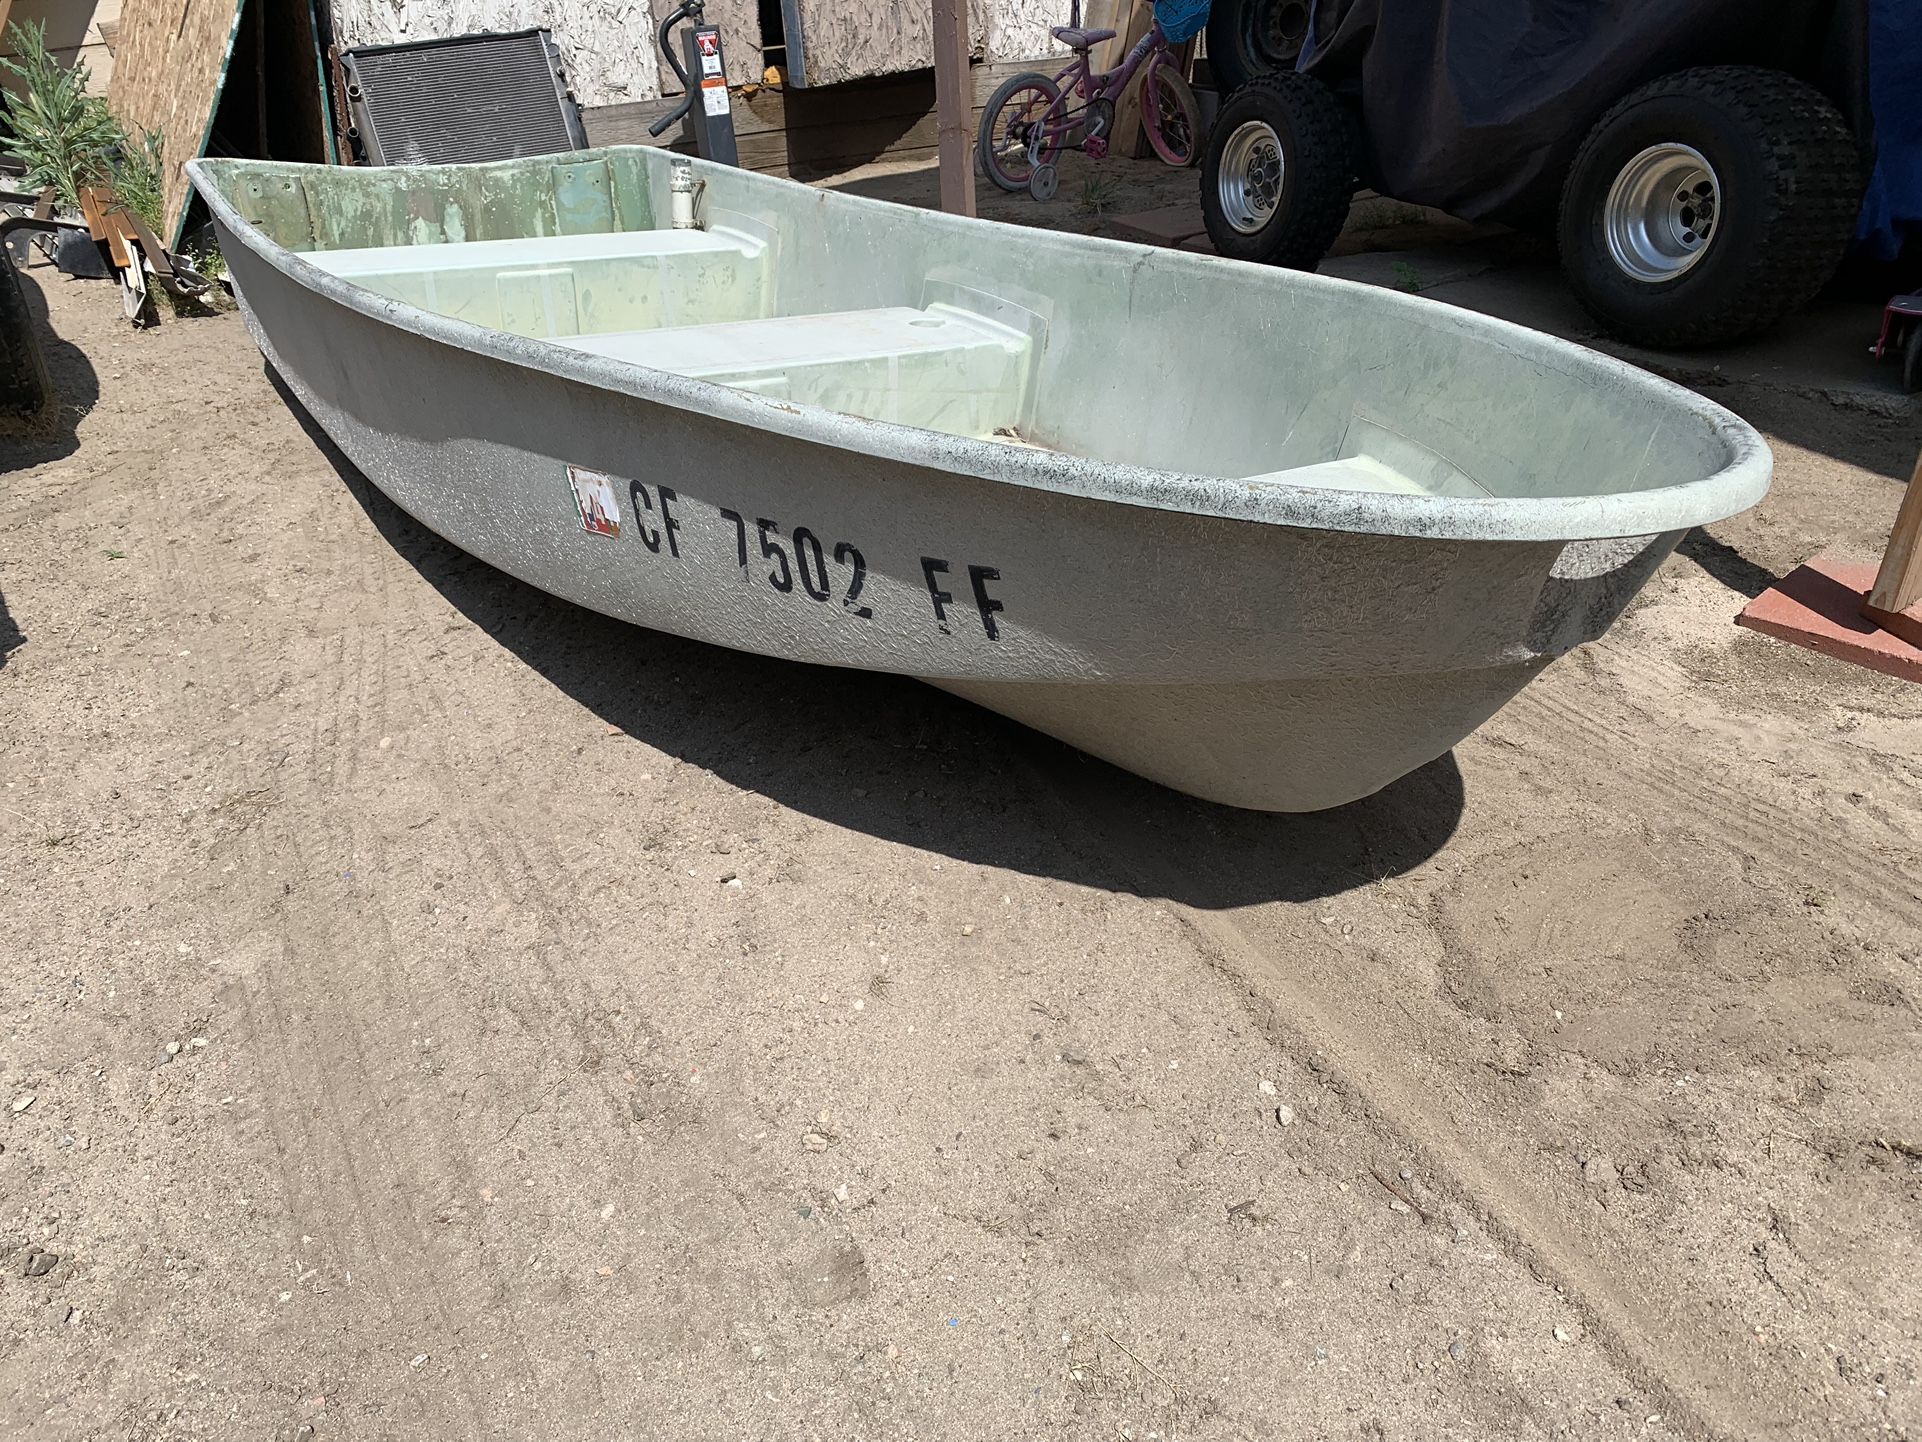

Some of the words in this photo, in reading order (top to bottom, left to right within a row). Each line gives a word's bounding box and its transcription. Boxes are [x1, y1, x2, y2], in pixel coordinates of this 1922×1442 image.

[629, 479, 681, 559] CF
[719, 507, 872, 619] 7502
[920, 556, 1004, 641] FF
